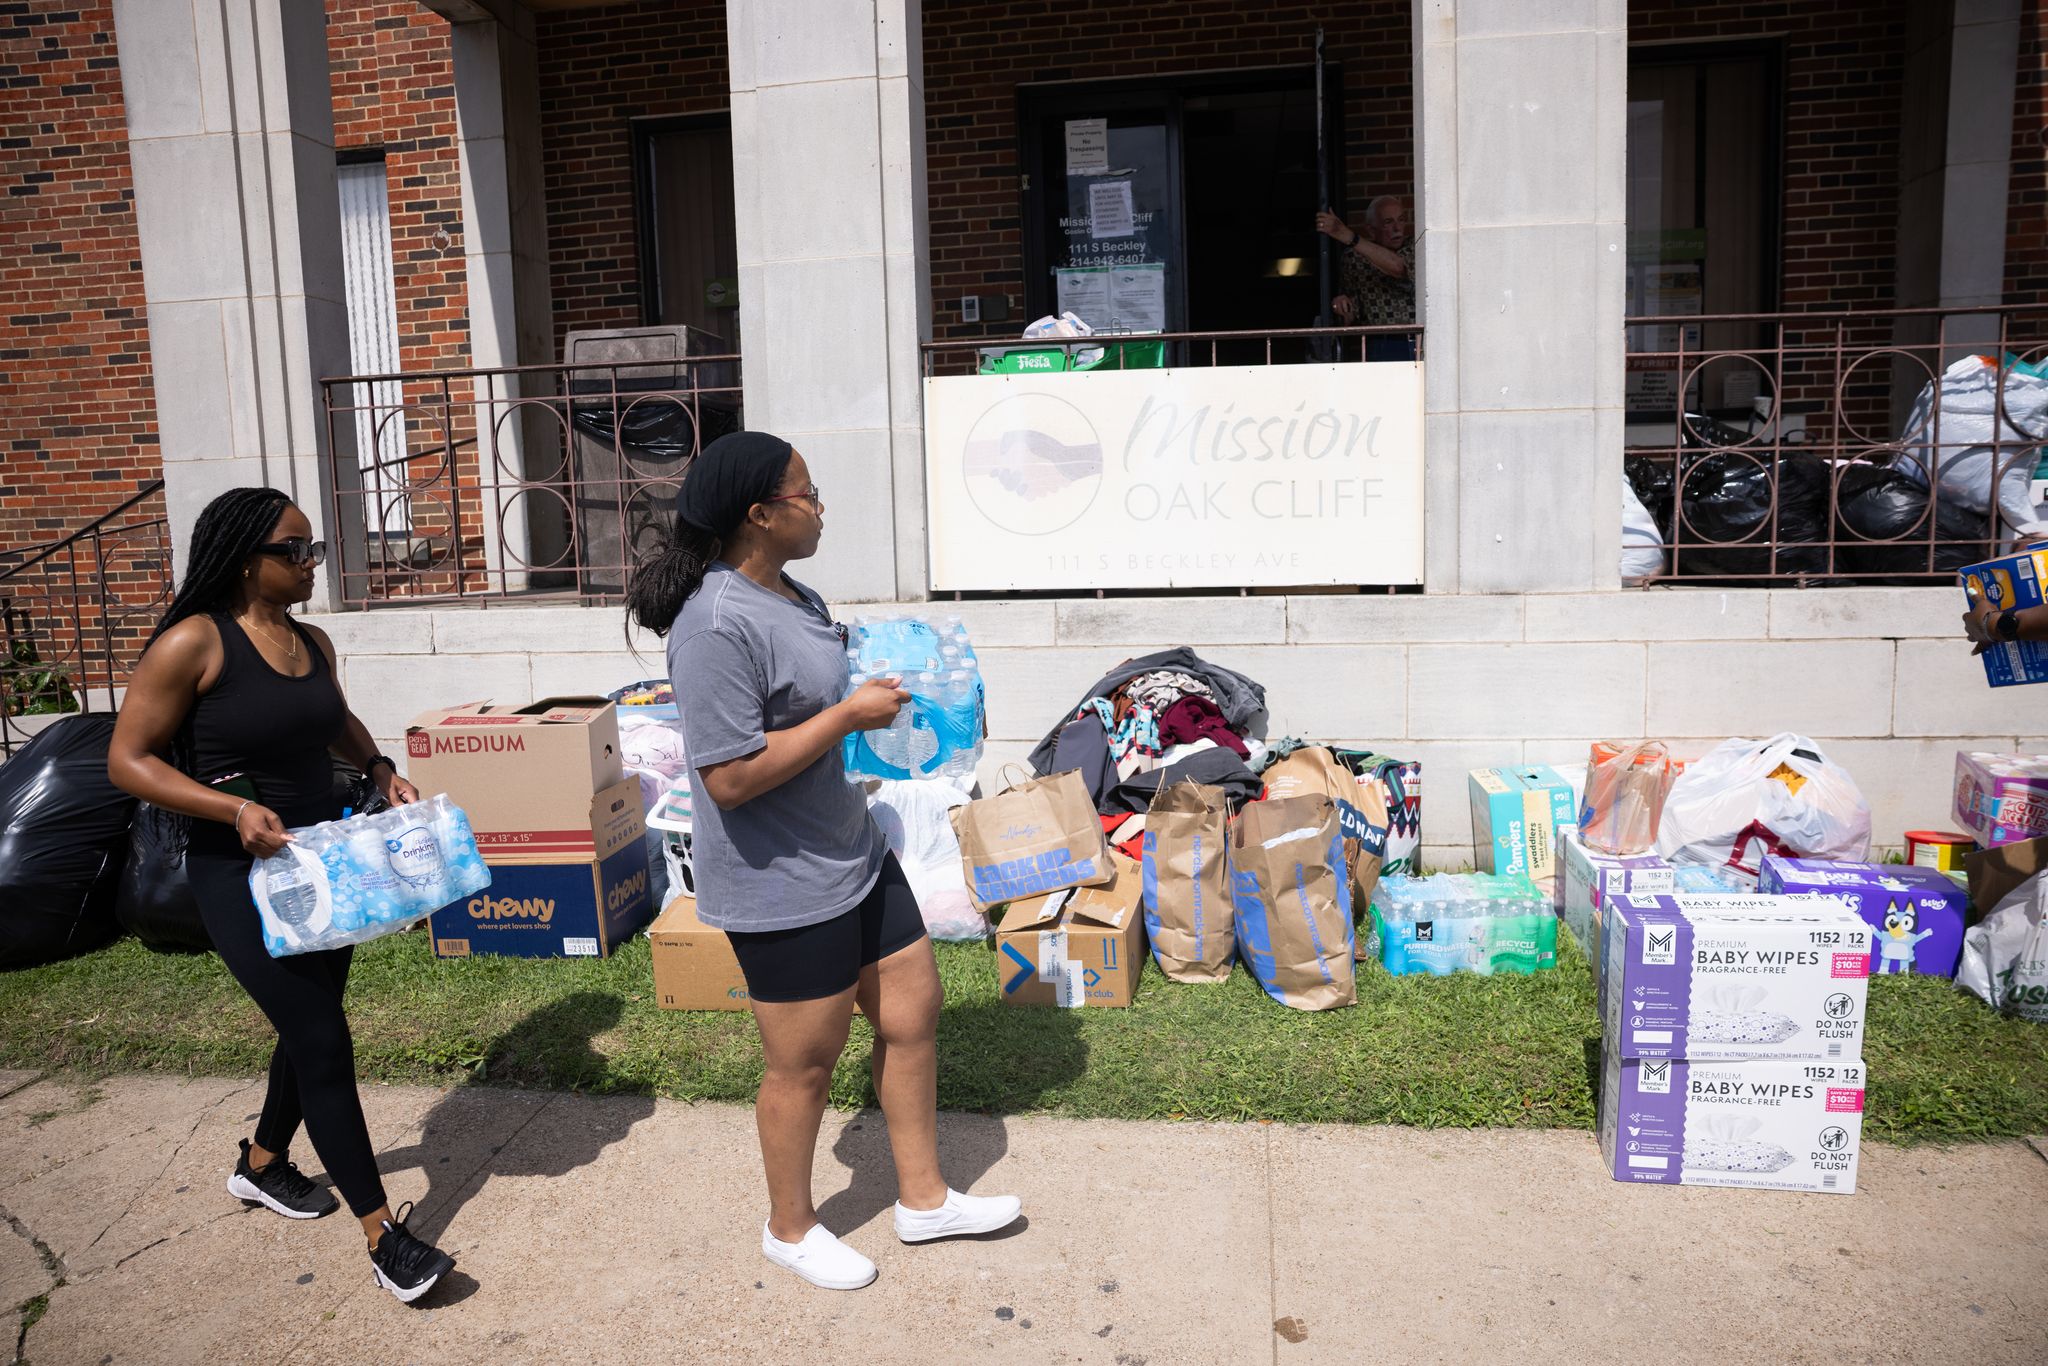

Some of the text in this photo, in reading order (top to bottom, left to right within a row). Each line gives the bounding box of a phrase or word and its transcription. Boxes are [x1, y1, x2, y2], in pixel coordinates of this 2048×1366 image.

[1060, 216, 1093, 227] Missio
[1068, 240, 1146, 254] 111 S Beckley
[1069, 253, 1146, 268] 214-942-6407
[1016, 354, 1052, 370] Fiesta
[1633, 360, 1697, 368] PERMITDO
[1122, 394, 1383, 473] Mission
[1123, 478, 1384, 522] OAK CLIFF
[1046, 552, 1300, 571] 111 S BECKLEY AVE
[411, 744, 428, 754] GEAR
[435, 734, 526, 754] MEDIUM
[2015, 801, 2046, 818] CUP
[1338, 806, 1356, 829] LD
[498, 834, 512, 842] 13"
[520, 833, 533, 842] 15"
[1506, 820, 1526, 875] Pampers
[1528, 822, 1540, 869] swaddlers
[608, 868, 646, 911] chewy
[467, 894, 555, 922] chewy
[534, 922, 551, 930] shop
[1809, 932, 1864, 944] 1152 12
[1404, 942, 1470, 952] PURIFIED WATER
[1496, 940, 1536, 948] RECYCLE
[1698, 940, 1747, 948] PREMIUM
[1697, 952, 1819, 965] BABY WIPES
[1696, 966, 1787, 974] FRAGRANCE-FREE
[1835, 961, 1852, 969] $10
[1816, 1020, 1858, 1030] DO NOT
[1819, 1030, 1853, 1039] FLUSH
[1692, 1071, 1742, 1080] PREMIUM
[1804, 1067, 1859, 1080] 1152 12
[1692, 1081, 1814, 1098] BABY WIPES
[1691, 1096, 1782, 1106] FRAGRANCE-FREE
[1830, 1096, 1847, 1104] $10
[1811, 1152, 1854, 1162] DO NOT
[1814, 1162, 1848, 1171] FLUSH
